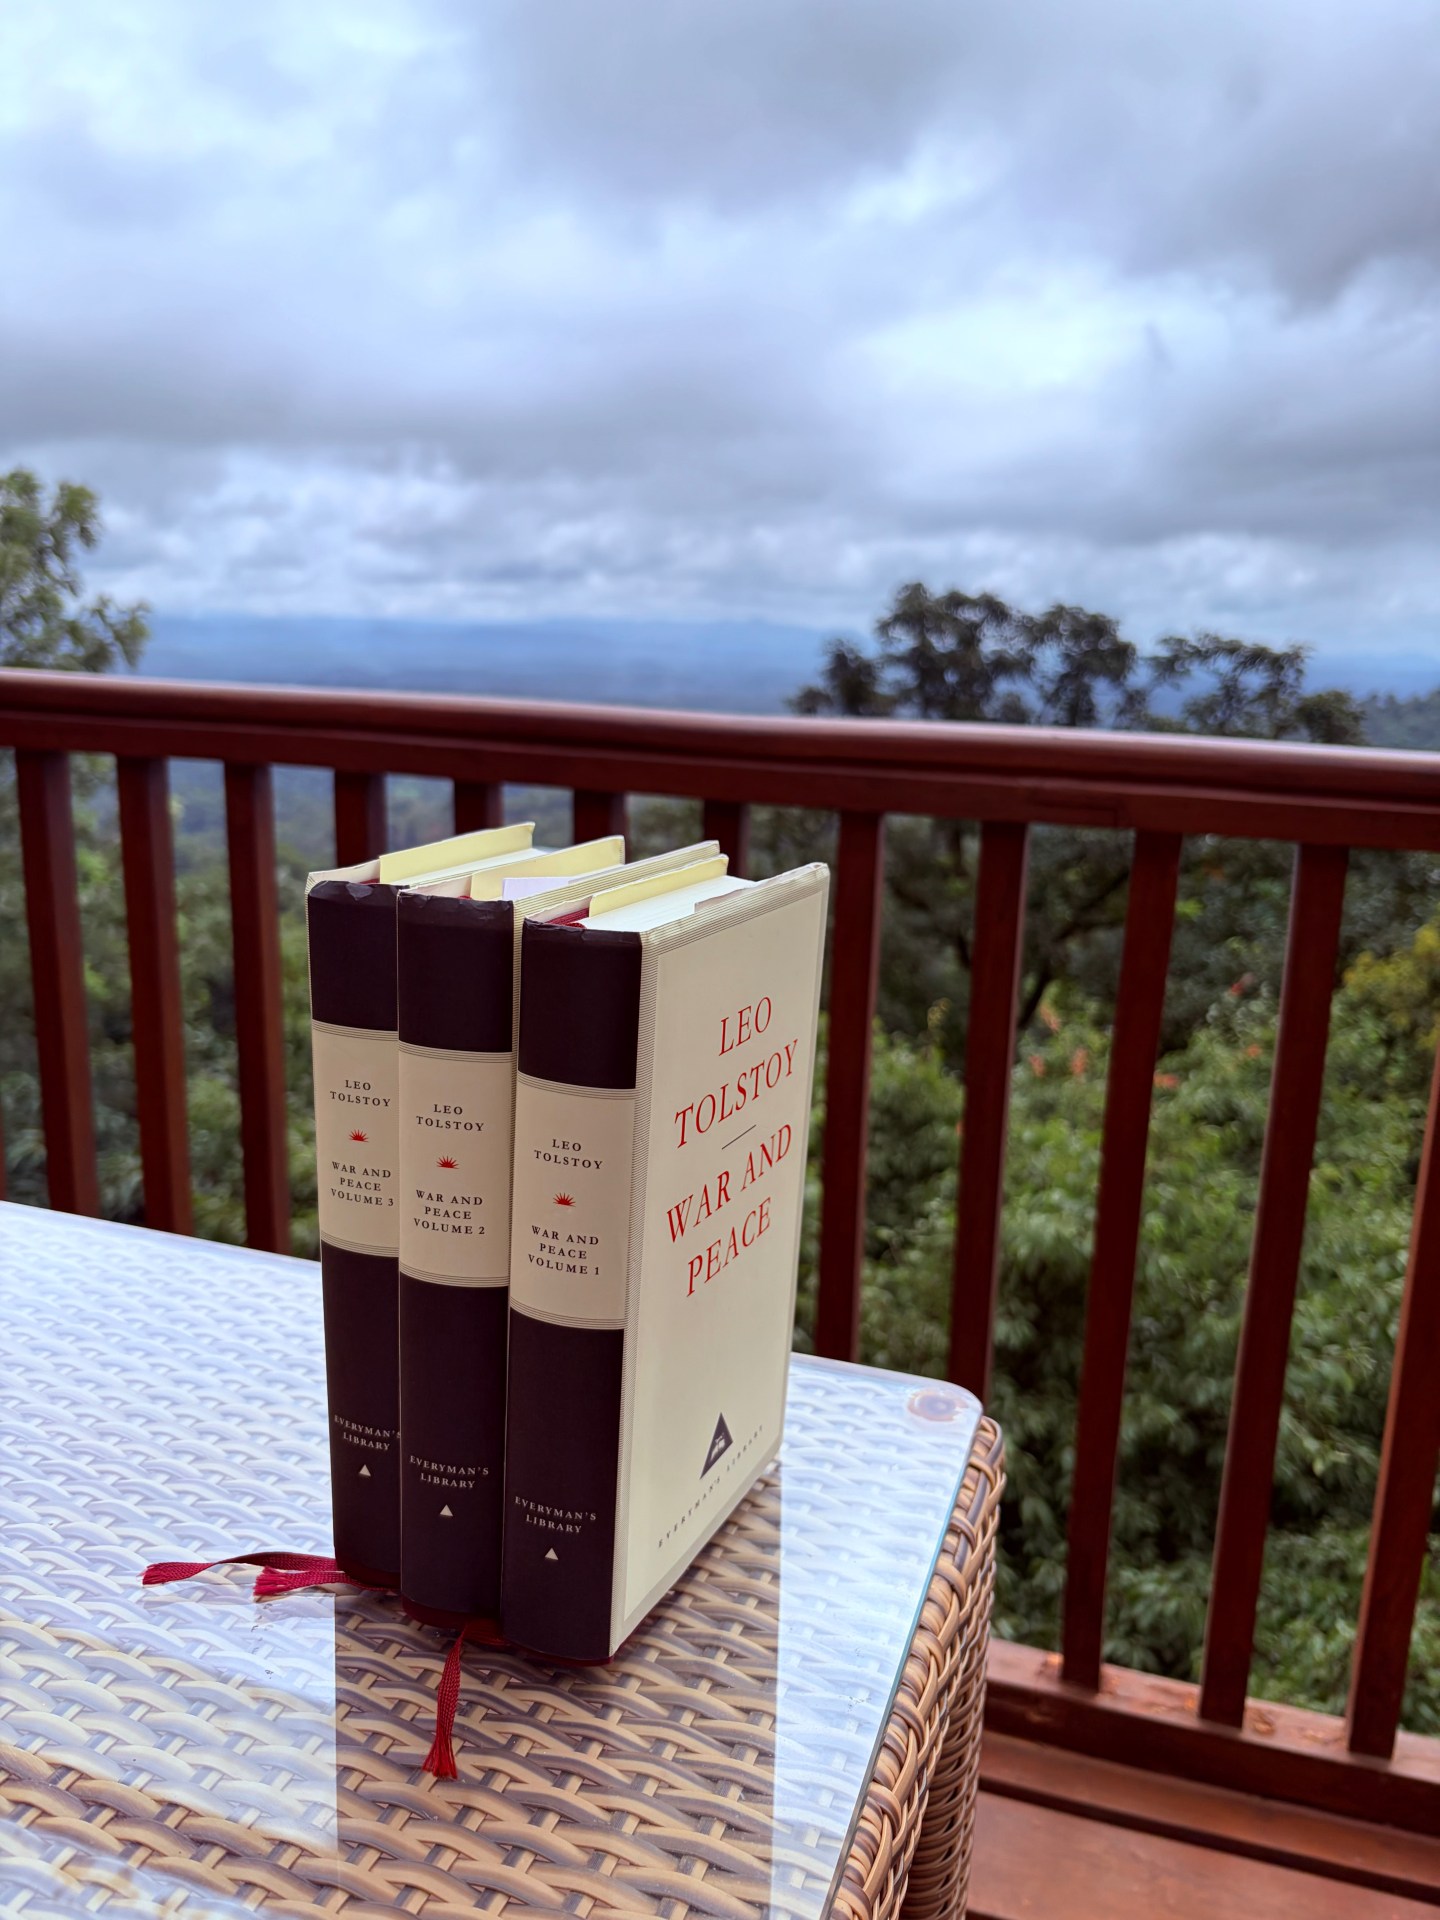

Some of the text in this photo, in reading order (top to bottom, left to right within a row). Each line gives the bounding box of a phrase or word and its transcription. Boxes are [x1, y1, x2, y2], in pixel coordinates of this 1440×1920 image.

[719, 996, 772, 1056] LEO
[345, 1079, 371, 1091] LEO
[330, 1091, 391, 1107] TOLSTOY
[674, 1039, 798, 1149] TOLSTOY
[434, 1104, 463, 1115] LEO
[416, 1116, 485, 1132] TOLSTOY
[552, 1139, 582, 1152] LEO
[534, 1150, 603, 1170] TOLSTOY
[332, 1161, 391, 1178] WAR AND
[340, 1177, 381, 1191] PEACE
[667, 1124, 792, 1244] WAR AND
[331, 1189, 394, 1206] VOLUME 3
[416, 1190, 483, 1206] WAR AND
[425, 1206, 471, 1220] PEACE
[414, 1218, 485, 1235] VOLUME 2
[531, 1225, 599, 1245] WAR AND
[539, 1243, 587, 1259] PEACE
[686, 1196, 771, 1297] PEACE
[528, 1254, 600, 1276] VOLUME 1
[343, 1432, 390, 1451] LIBRARY
[410, 1455, 489, 1476] EVERYMAN'S
[420, 1472, 475, 1489] LIBRARY
[515, 1496, 596, 1521] EVERYMAN'S
[525, 1514, 582, 1533] LIBRARY
